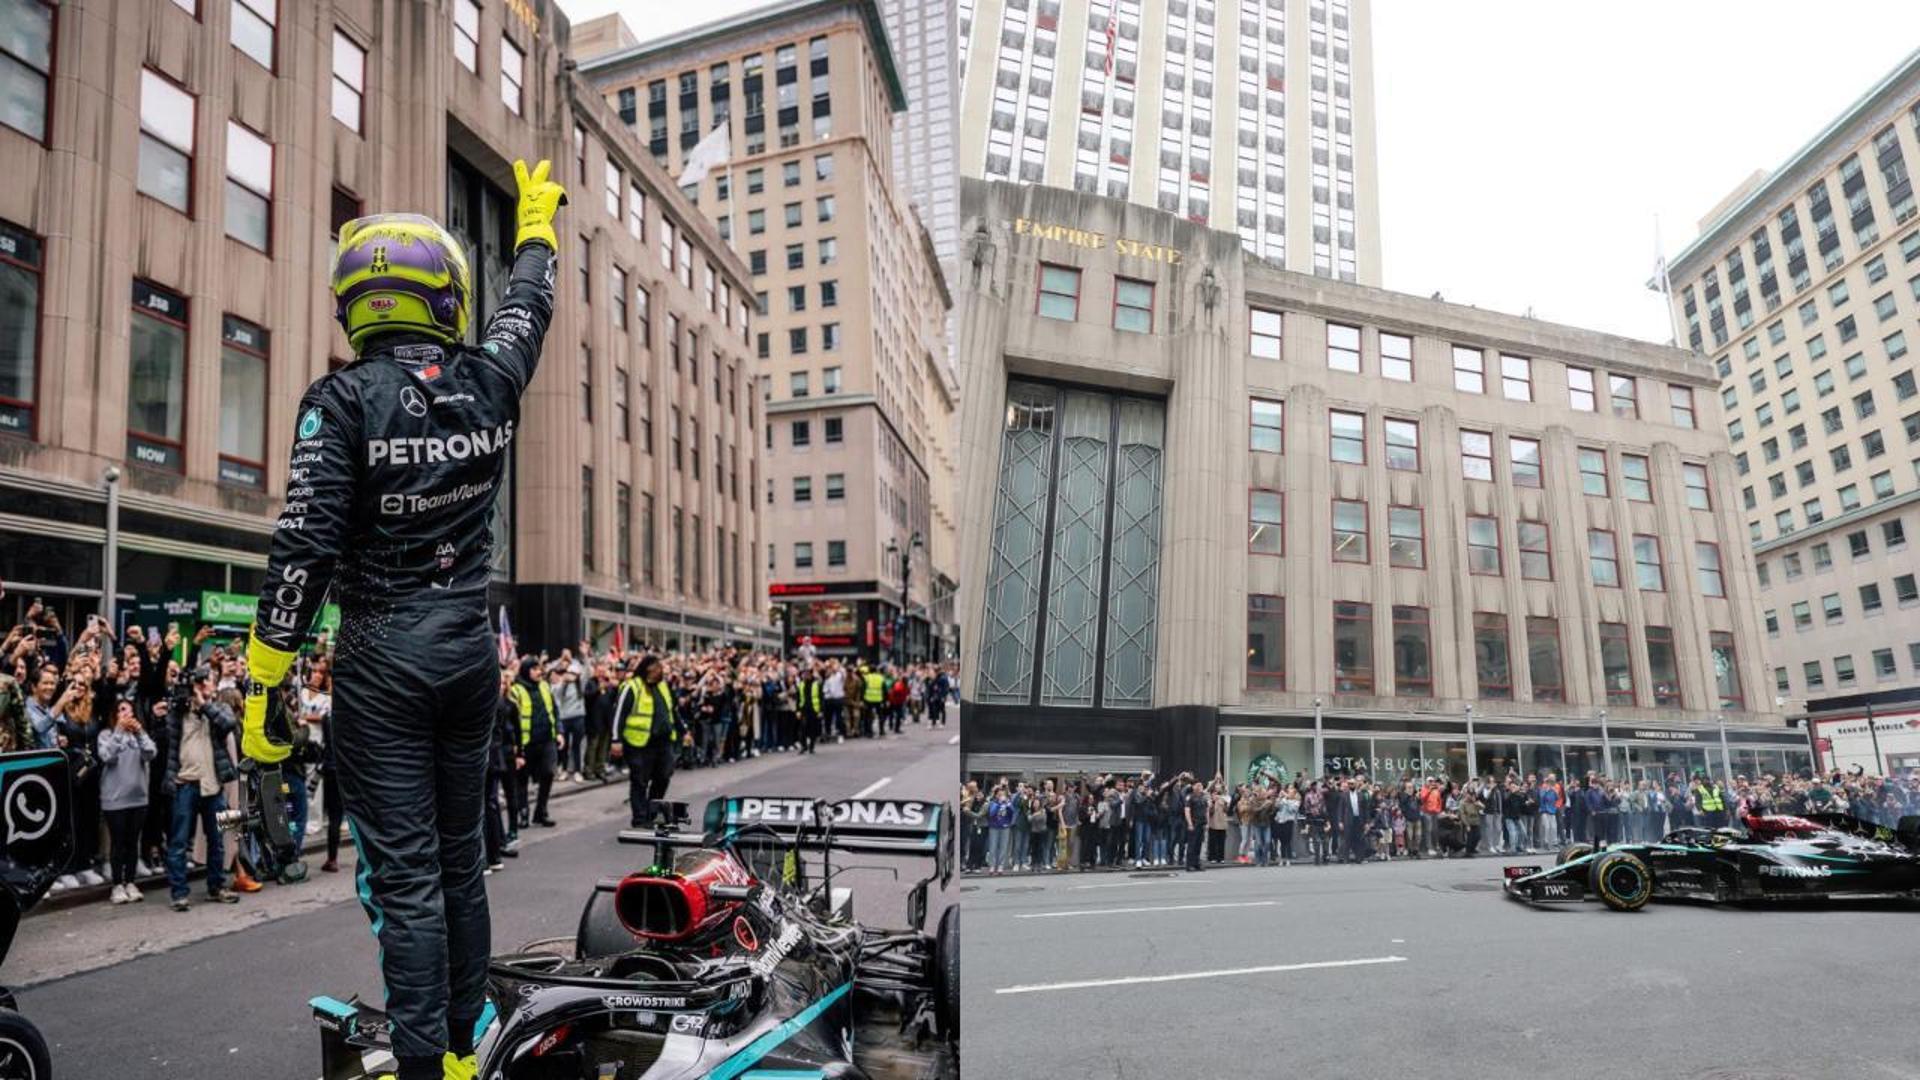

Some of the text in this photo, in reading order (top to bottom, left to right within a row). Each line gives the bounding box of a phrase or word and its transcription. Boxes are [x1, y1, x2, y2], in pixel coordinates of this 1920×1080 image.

[1015, 218, 1184, 264] EMPIRE STATE
[368, 420, 513, 466] PETRONAS
[136, 446, 166, 464] NOW
[1332, 756, 1446, 771] STARBUCKS
[1758, 865, 1832, 877] PETRONAS
[1544, 884, 1569, 896] IWC
[607, 996, 686, 1008] CROWDSTRIKE
